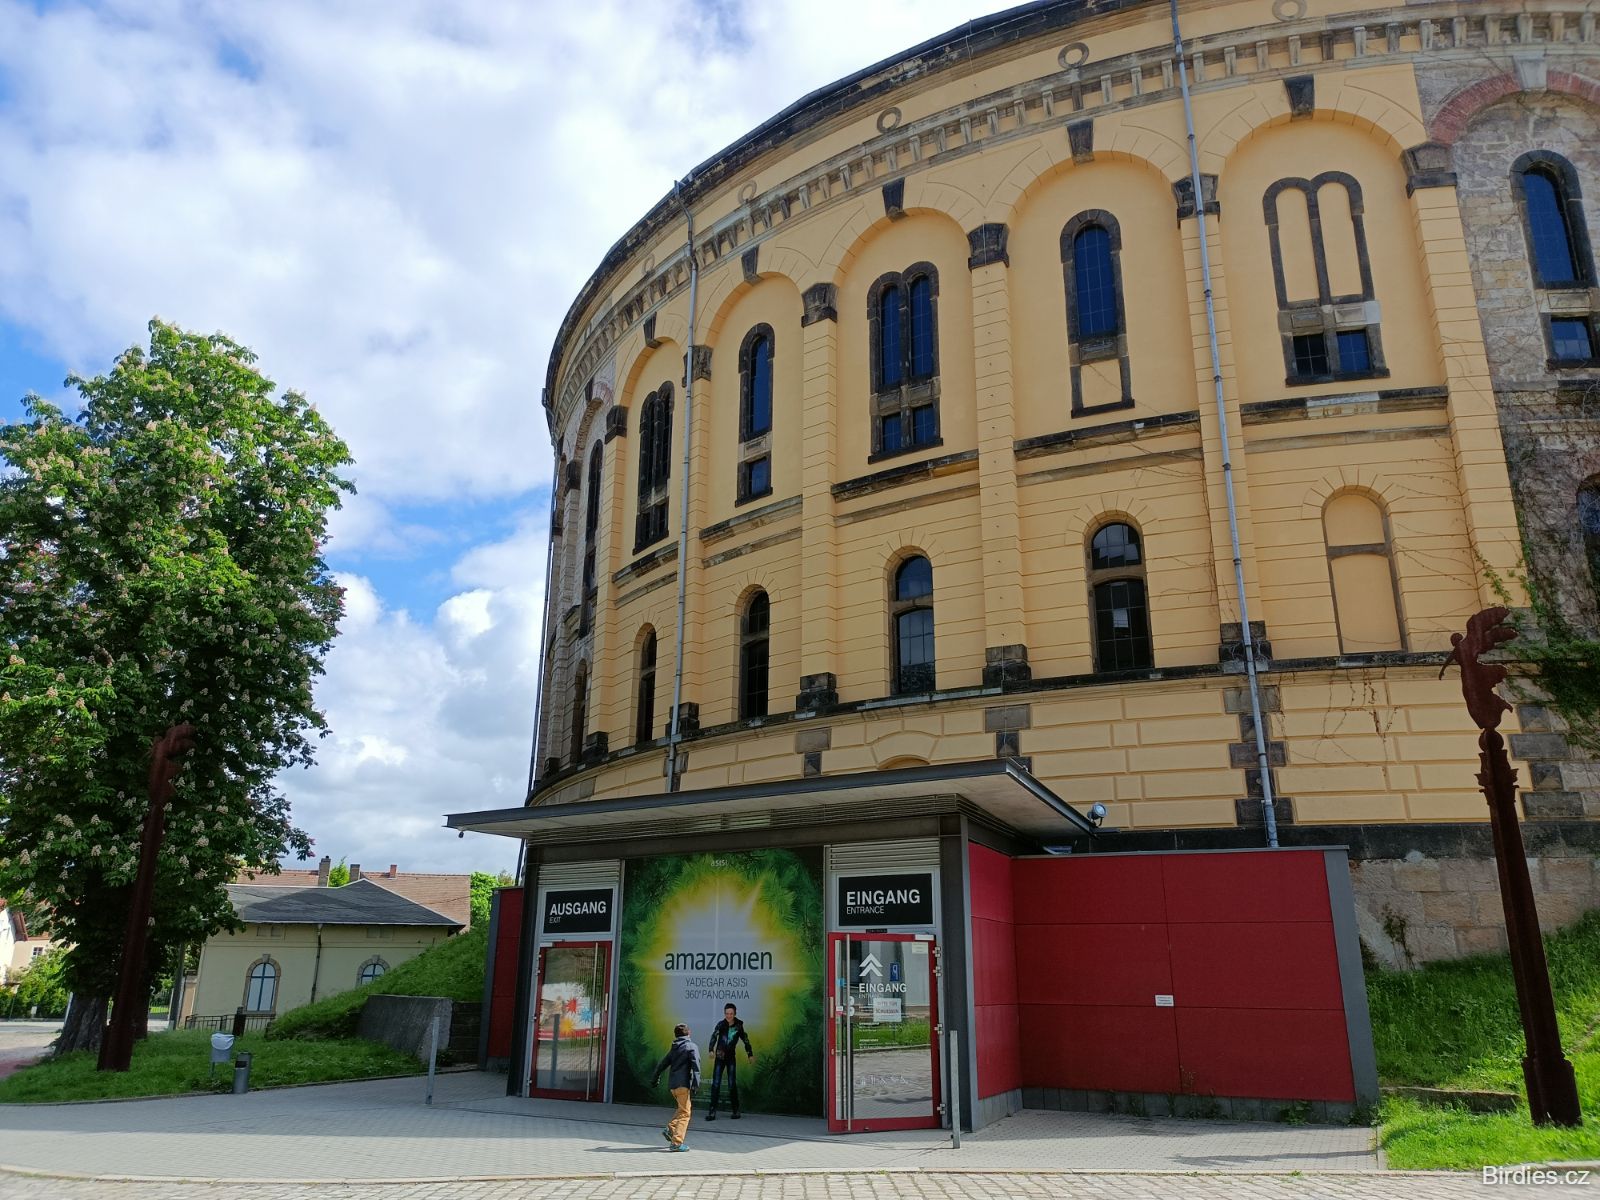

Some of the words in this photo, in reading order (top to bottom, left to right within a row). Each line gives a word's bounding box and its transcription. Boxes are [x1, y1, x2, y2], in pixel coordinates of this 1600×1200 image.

[846, 889, 921, 906] EINGANG
[549, 901, 607, 916] AUSGANG
[846, 906, 885, 915] ENTRANCE
[549, 916, 561, 924] EXIT
[664, 951, 773, 970] amazonien
[685, 977, 725, 987] YADEGAR
[727, 977, 748, 987] ASISI
[858, 983, 907, 993] EINGANG
